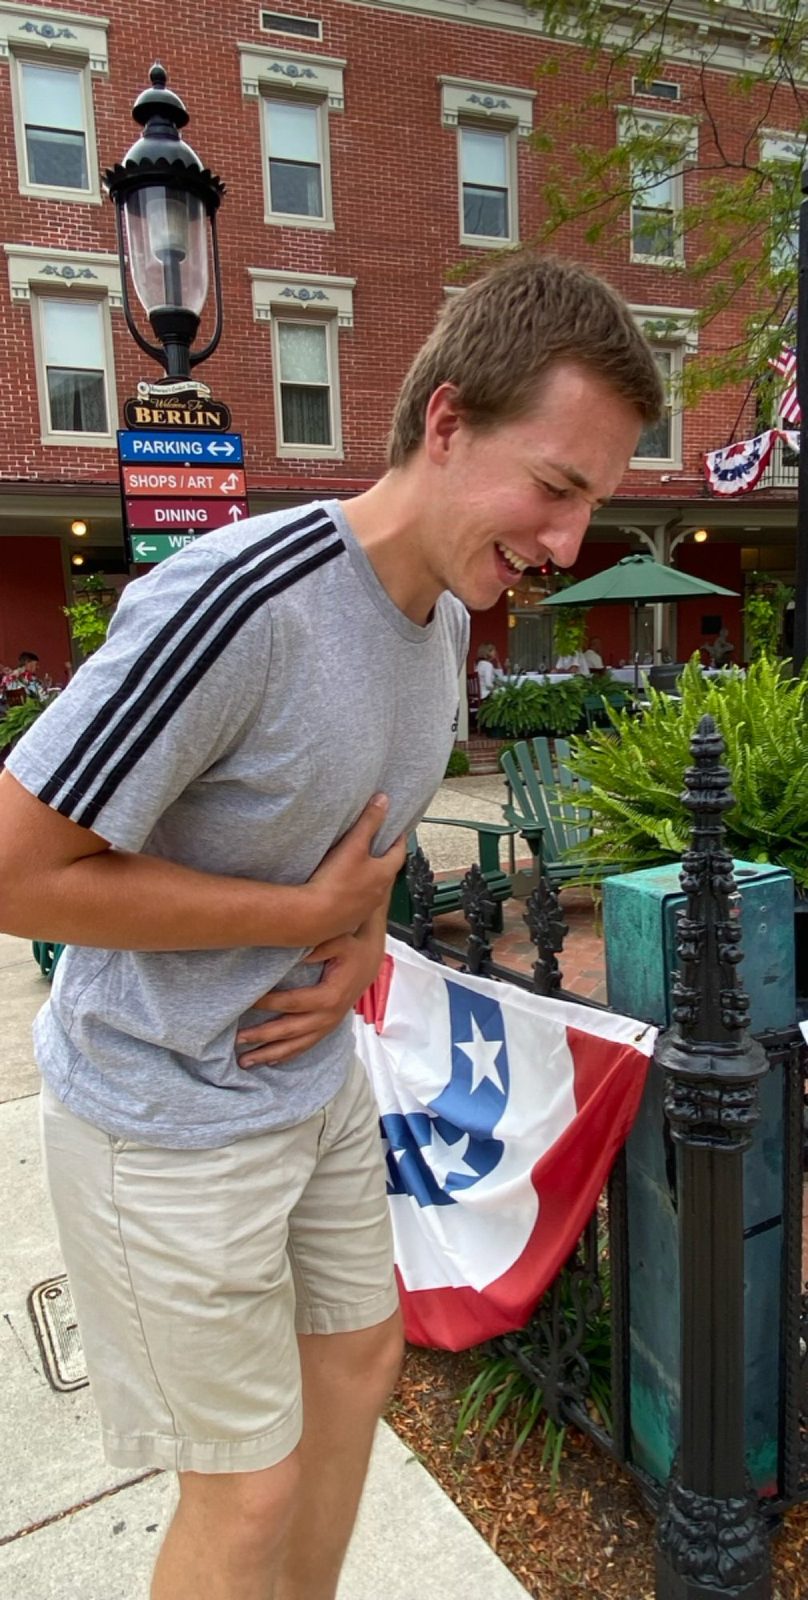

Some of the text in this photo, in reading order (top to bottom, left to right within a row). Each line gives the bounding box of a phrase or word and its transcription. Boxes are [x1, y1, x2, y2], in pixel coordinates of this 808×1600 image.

[134, 406, 221, 427] BERLIN
[133, 440, 203, 455] PARKING
[129, 474, 214, 489] SHOPS / ART
[154, 508, 208, 522] DINING
